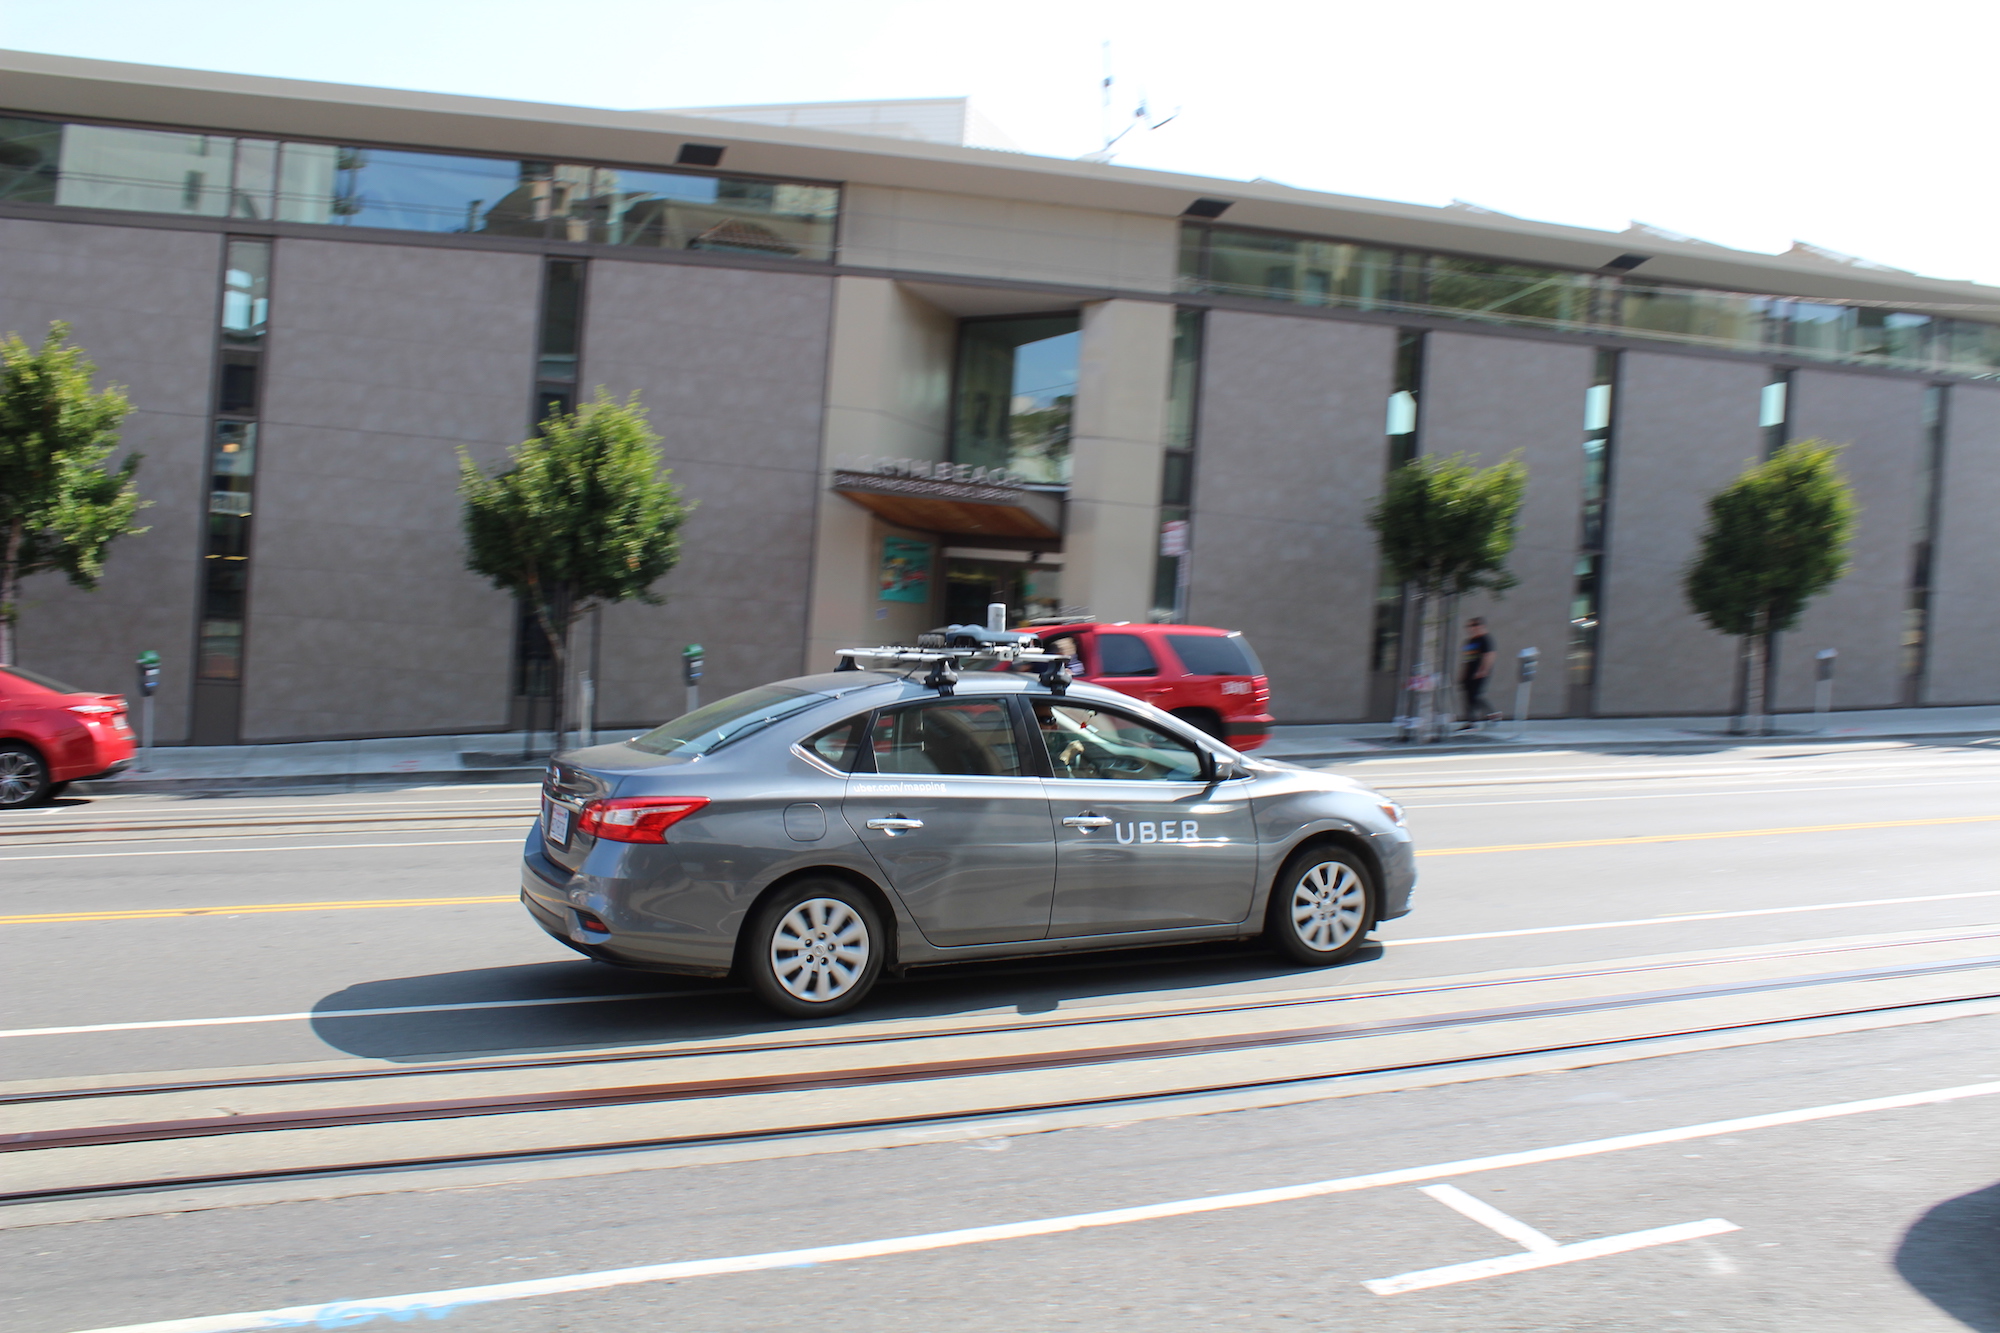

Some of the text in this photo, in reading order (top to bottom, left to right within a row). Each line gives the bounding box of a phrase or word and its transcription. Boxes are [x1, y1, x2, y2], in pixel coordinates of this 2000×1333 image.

[935, 461, 1024, 487] BEACH
[853, 781, 947, 793] uber.com/mapping
[1115, 820, 1199, 845] UBER
